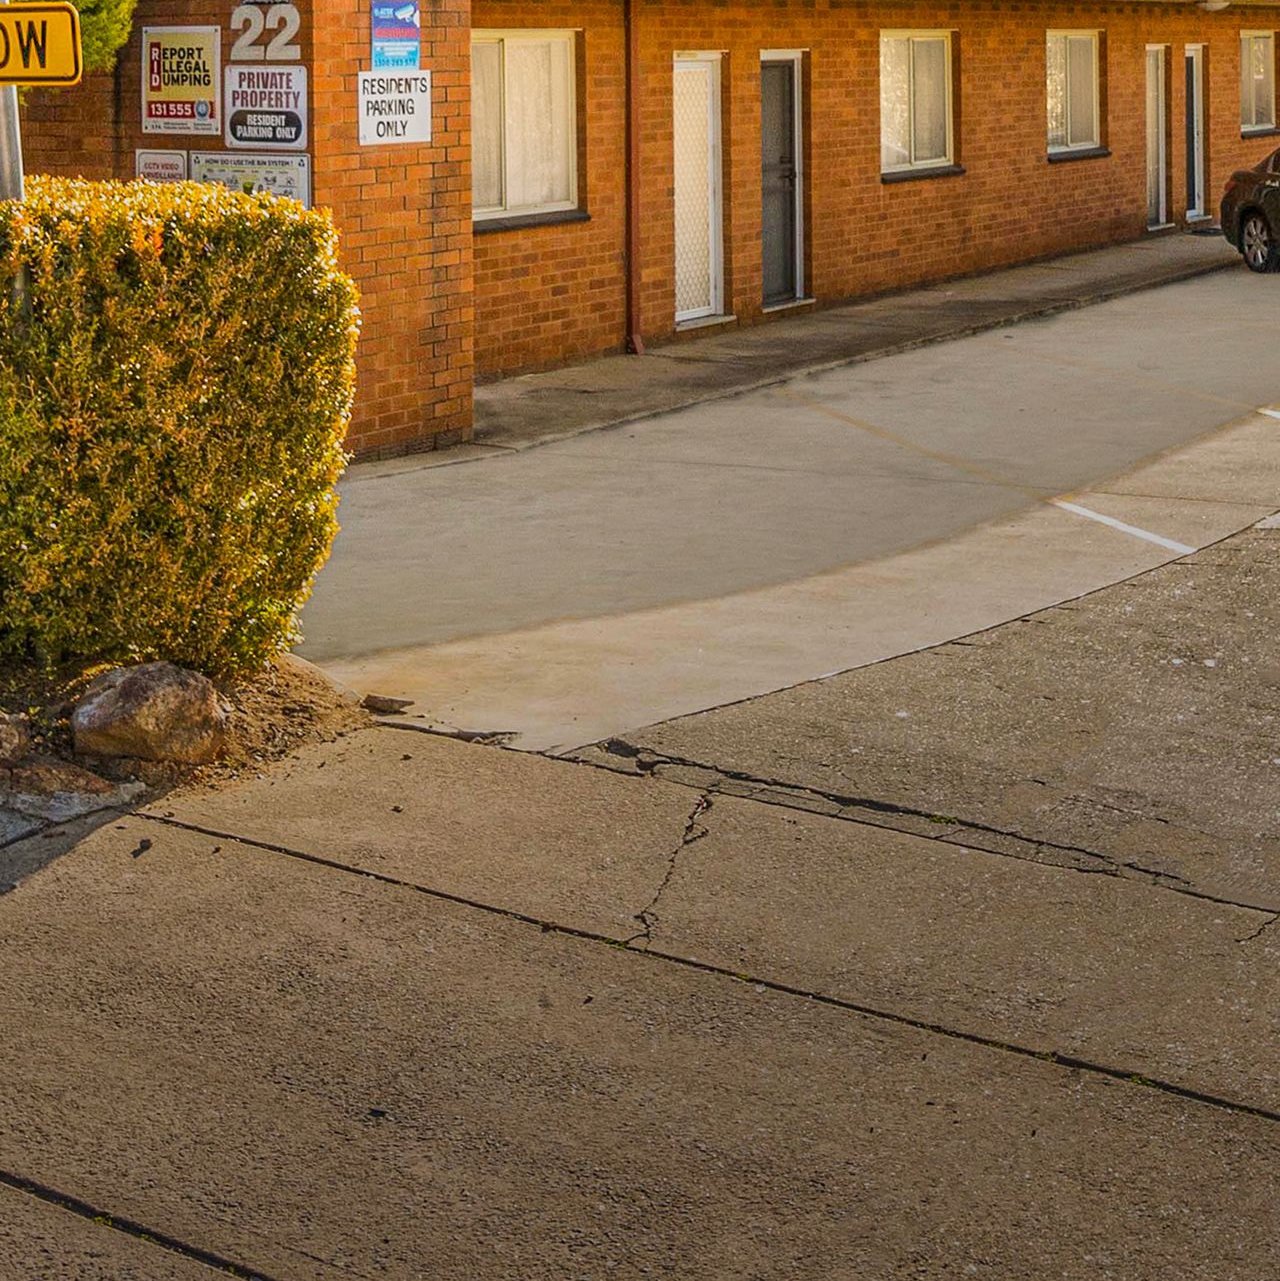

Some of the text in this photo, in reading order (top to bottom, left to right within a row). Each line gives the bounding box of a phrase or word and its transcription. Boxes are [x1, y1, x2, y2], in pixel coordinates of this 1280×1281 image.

[230, 4, 301, 60] 22
[151, 47, 203, 60] REPORT
[153, 61, 210, 73] ILLEGAL
[151, 74, 211, 87] DUMPING
[238, 71, 293, 89] PRIVATE
[363, 77, 427, 95] RESIDENTS
[232, 90, 300, 109] PROPERTY
[366, 98, 415, 116] PARKING
[151, 103, 167, 116] 131
[168, 103, 192, 116] 555
[247, 114, 286, 126] RESIDENT
[236, 125, 297, 139] PARKING ONLY
[376, 120, 408, 137] ONLY
